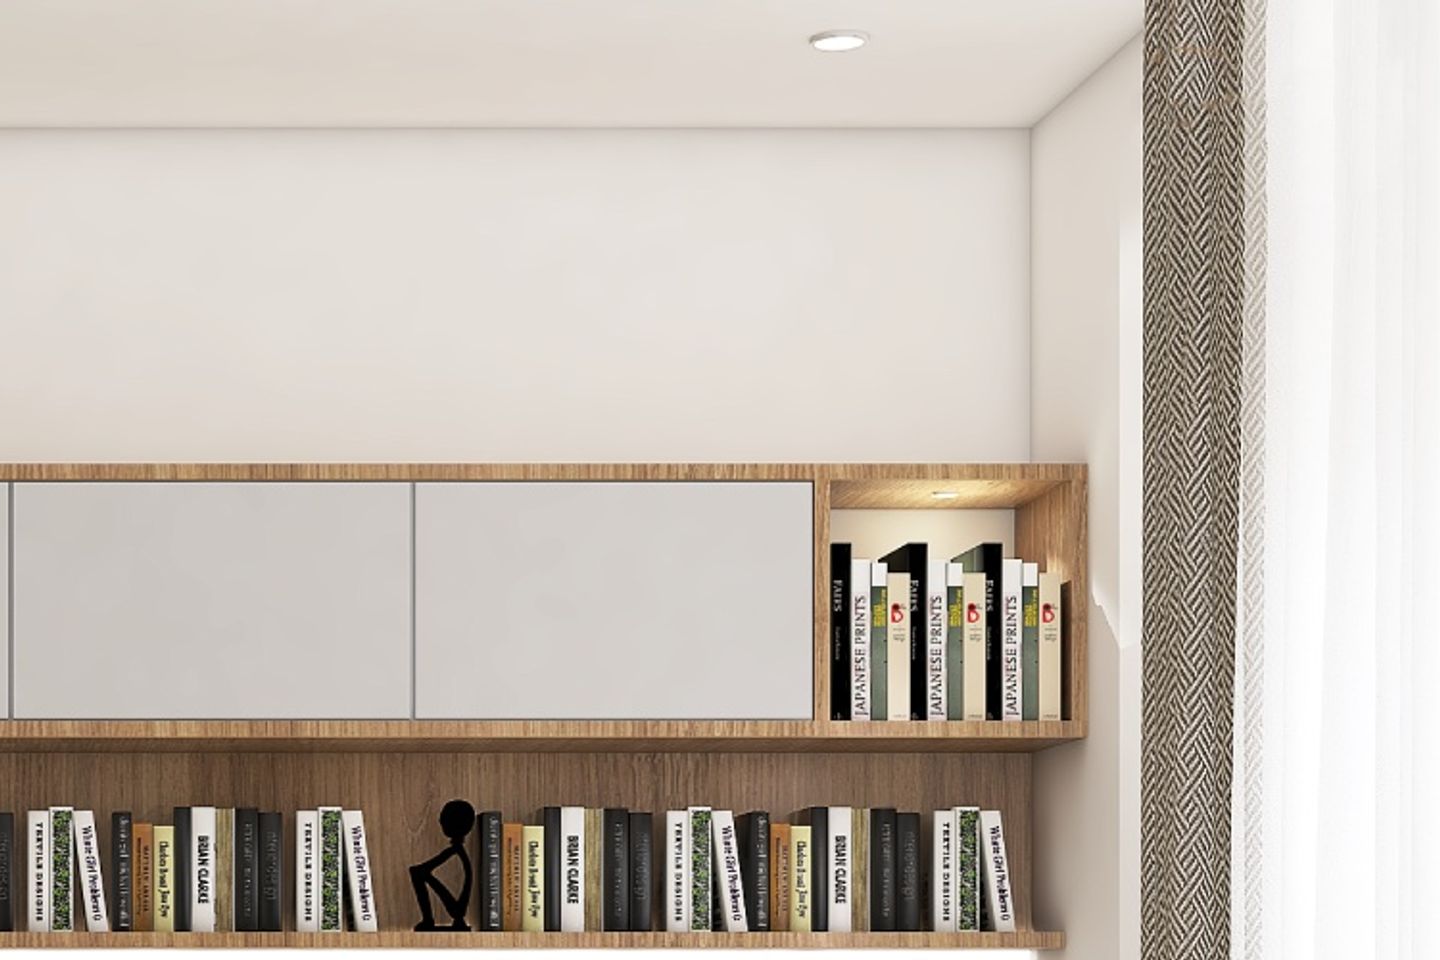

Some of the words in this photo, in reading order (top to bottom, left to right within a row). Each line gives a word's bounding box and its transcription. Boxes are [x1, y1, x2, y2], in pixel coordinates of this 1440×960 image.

[855, 595, 868, 645] PRINTS
[931, 595, 943, 645] PRINTS
[1006, 595, 1019, 645] PRINTS
[855, 648, 868, 716] JAPANESE
[931, 648, 943, 716] JAPANESE
[1006, 648, 1019, 716] JAPANESE
[35, 822, 43, 870] TEXTILE
[197, 836, 209, 867] BRIAN
[304, 822, 312, 870] TEXTILE
[567, 836, 579, 867] BRIAN
[674, 822, 682, 870] TEXTILE
[835, 836, 847, 867] BRIAN
[942, 822, 950, 870] TEXTILE
[35, 873, 43, 922] DESIGNS
[197, 868, 209, 904] CLARKE
[304, 873, 312, 922] DESIGNS
[567, 868, 579, 904] CLARKE
[674, 873, 682, 922] DESIGNS
[835, 868, 847, 904] CLARKE
[942, 873, 950, 922] DESIGNS
